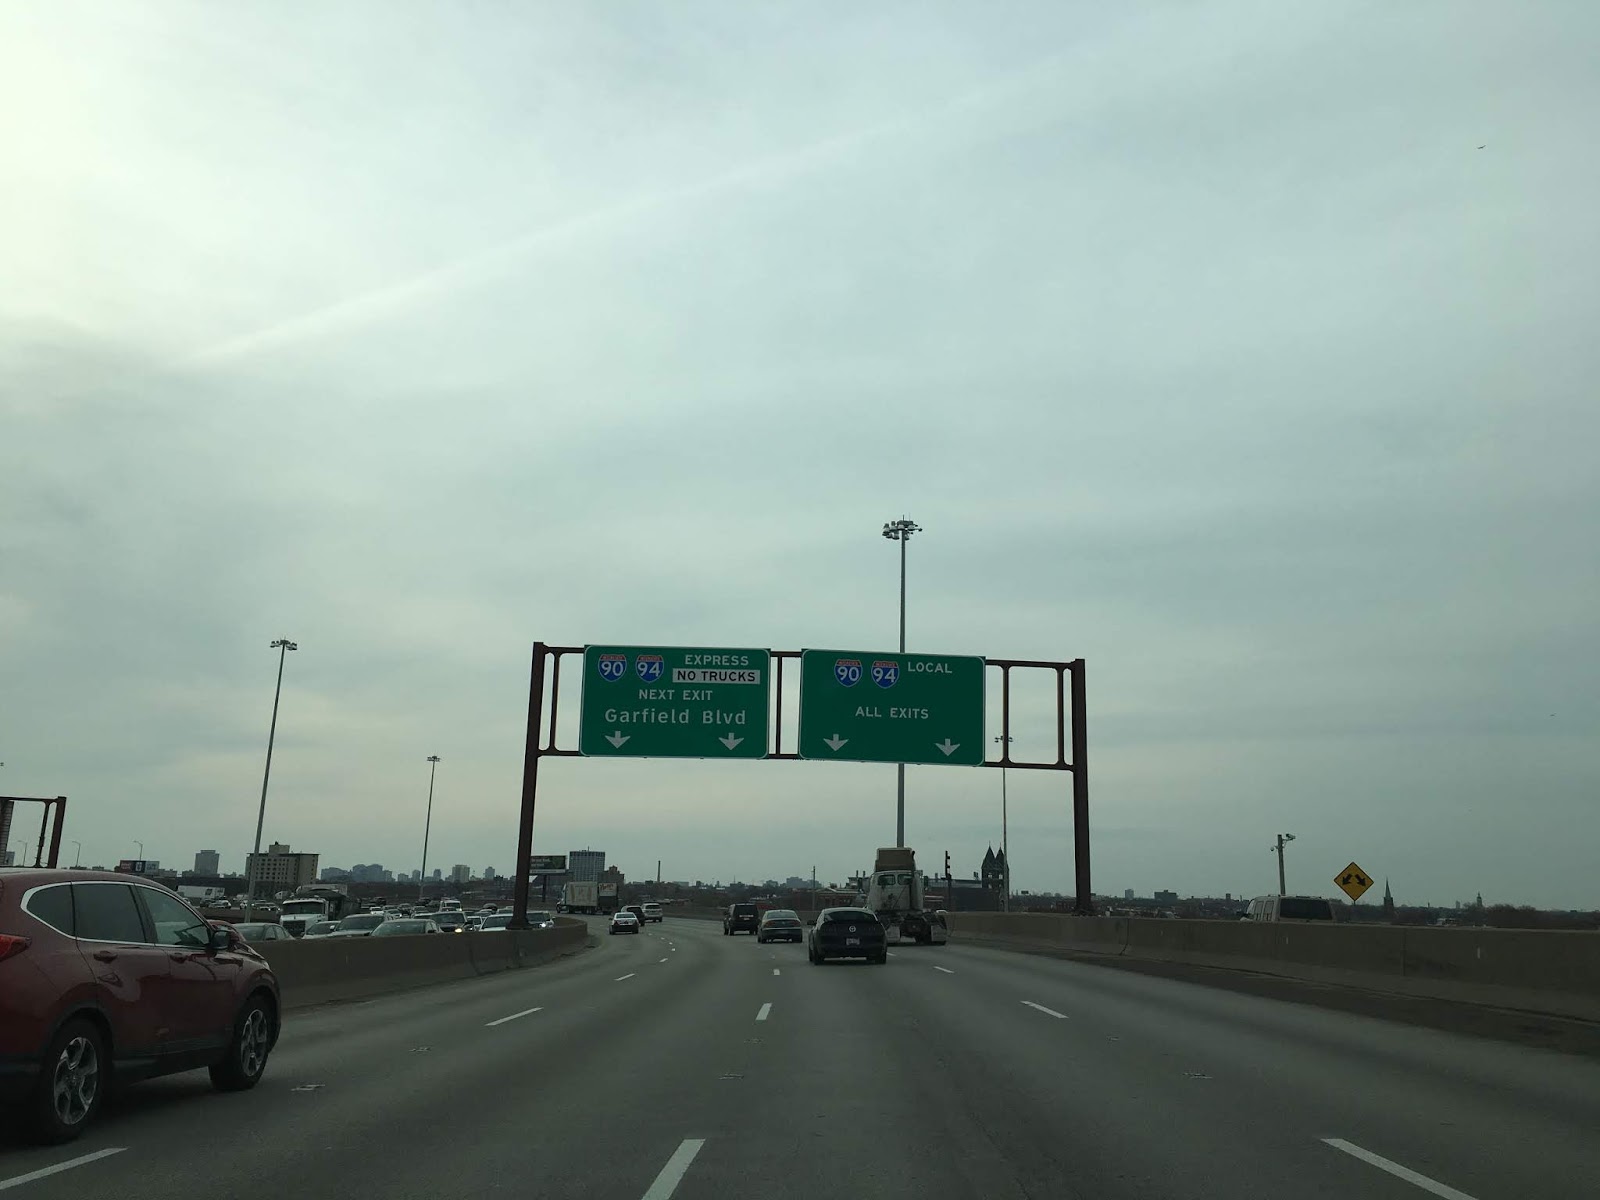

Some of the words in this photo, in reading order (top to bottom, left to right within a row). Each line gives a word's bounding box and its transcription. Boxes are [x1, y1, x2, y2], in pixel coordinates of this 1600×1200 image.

[685, 655, 749, 666] EXPRESS
[907, 661, 952, 674] LOCAL
[601, 661, 623, 676] 90
[638, 662, 661, 677] 94
[837, 666, 860, 682] 90
[873, 668, 896, 683] 94
[677, 670, 696, 681] NO
[701, 671, 756, 682] TRUCKS
[639, 689, 675, 700] NEXT
[683, 690, 713, 701] EXIT
[605, 708, 689, 724] Garfield
[702, 710, 746, 725] Blvd
[855, 706, 882, 718] ALL
[890, 707, 929, 719] EXITS
